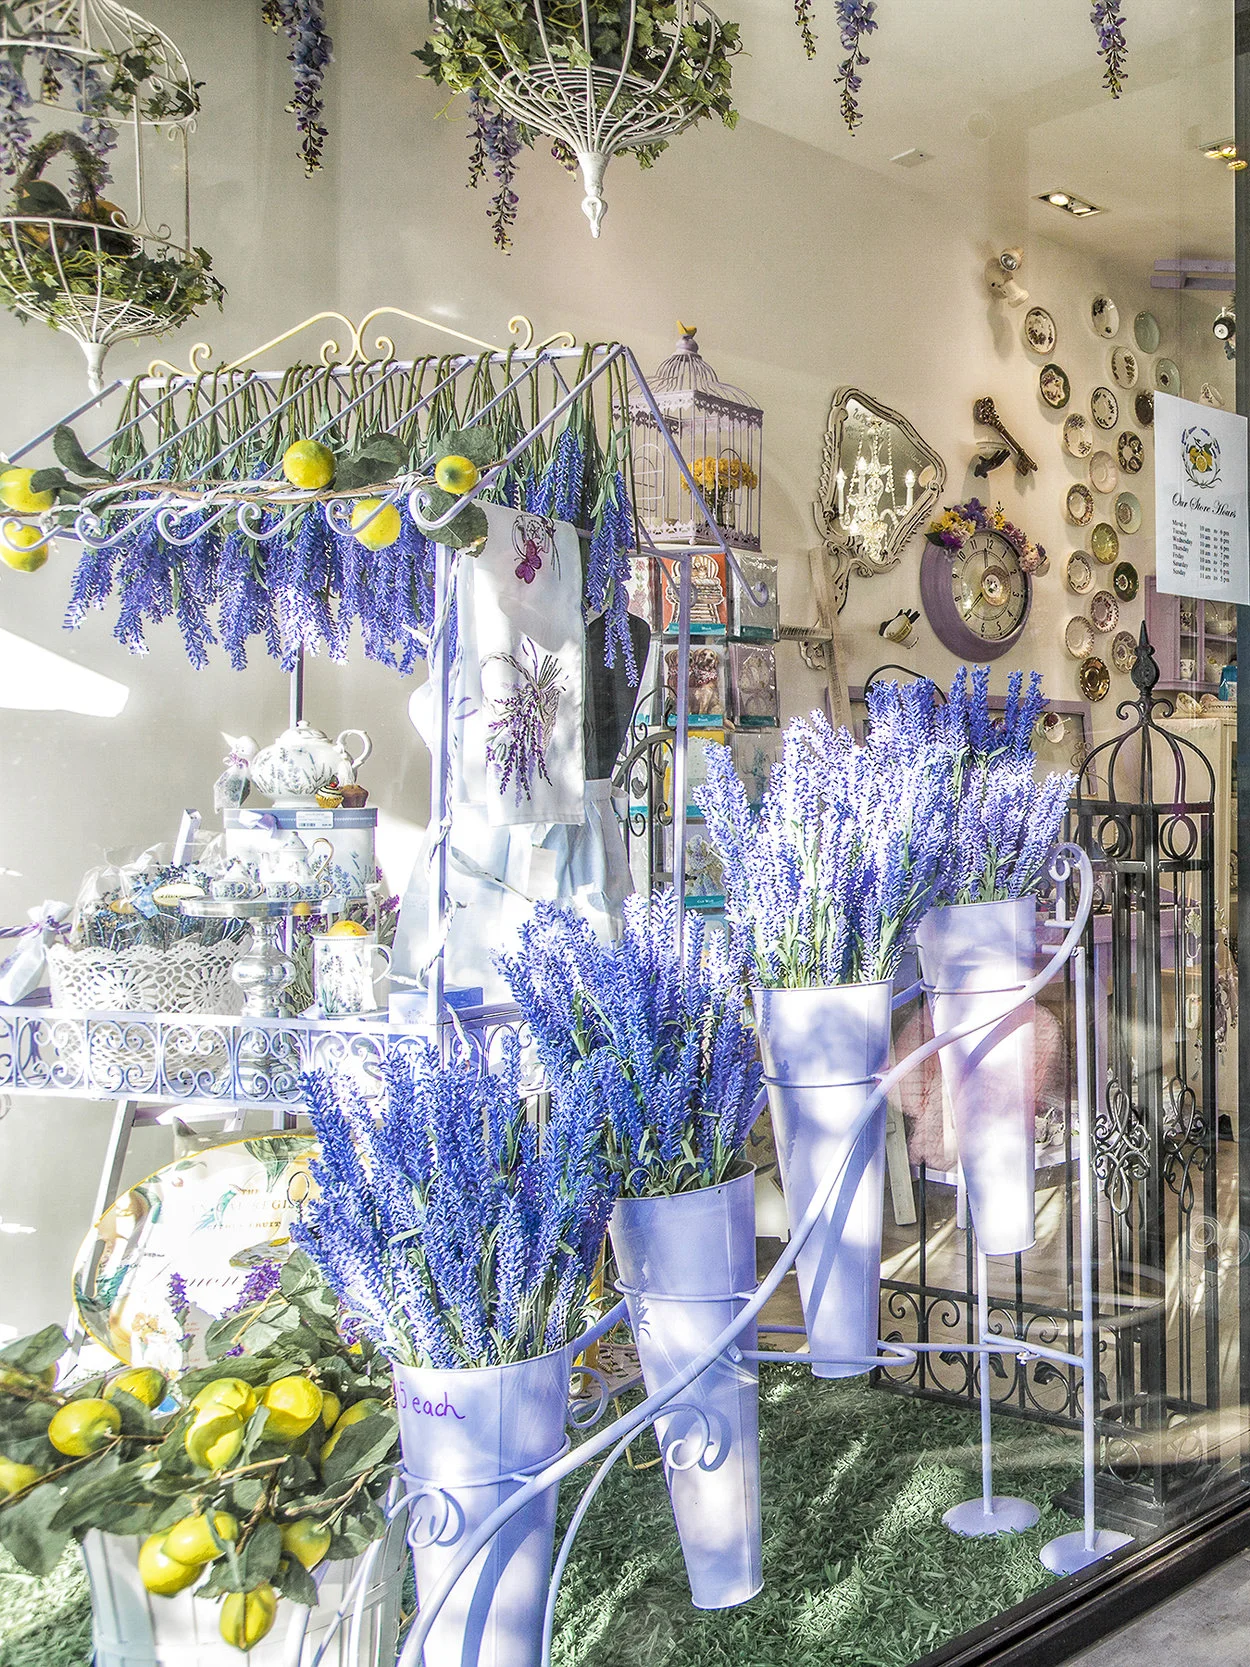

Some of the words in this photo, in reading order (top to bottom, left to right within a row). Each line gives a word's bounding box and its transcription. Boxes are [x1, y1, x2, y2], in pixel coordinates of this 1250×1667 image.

[1172, 492, 1188, 508] Our
[1190, 497, 1211, 511] Store
[1211, 500, 1237, 518] Hours
[970, 539, 978, 550] 11
[987, 539, 994, 550] 12
[957, 551, 967, 562] 10
[1001, 550, 1008, 559] 1
[965, 614, 972, 622] 7
[1007, 610, 1014, 618] 4
[980, 623, 985, 633] 6
[996, 621, 1002, 631] 5
[412, 1391, 467, 1420] each
